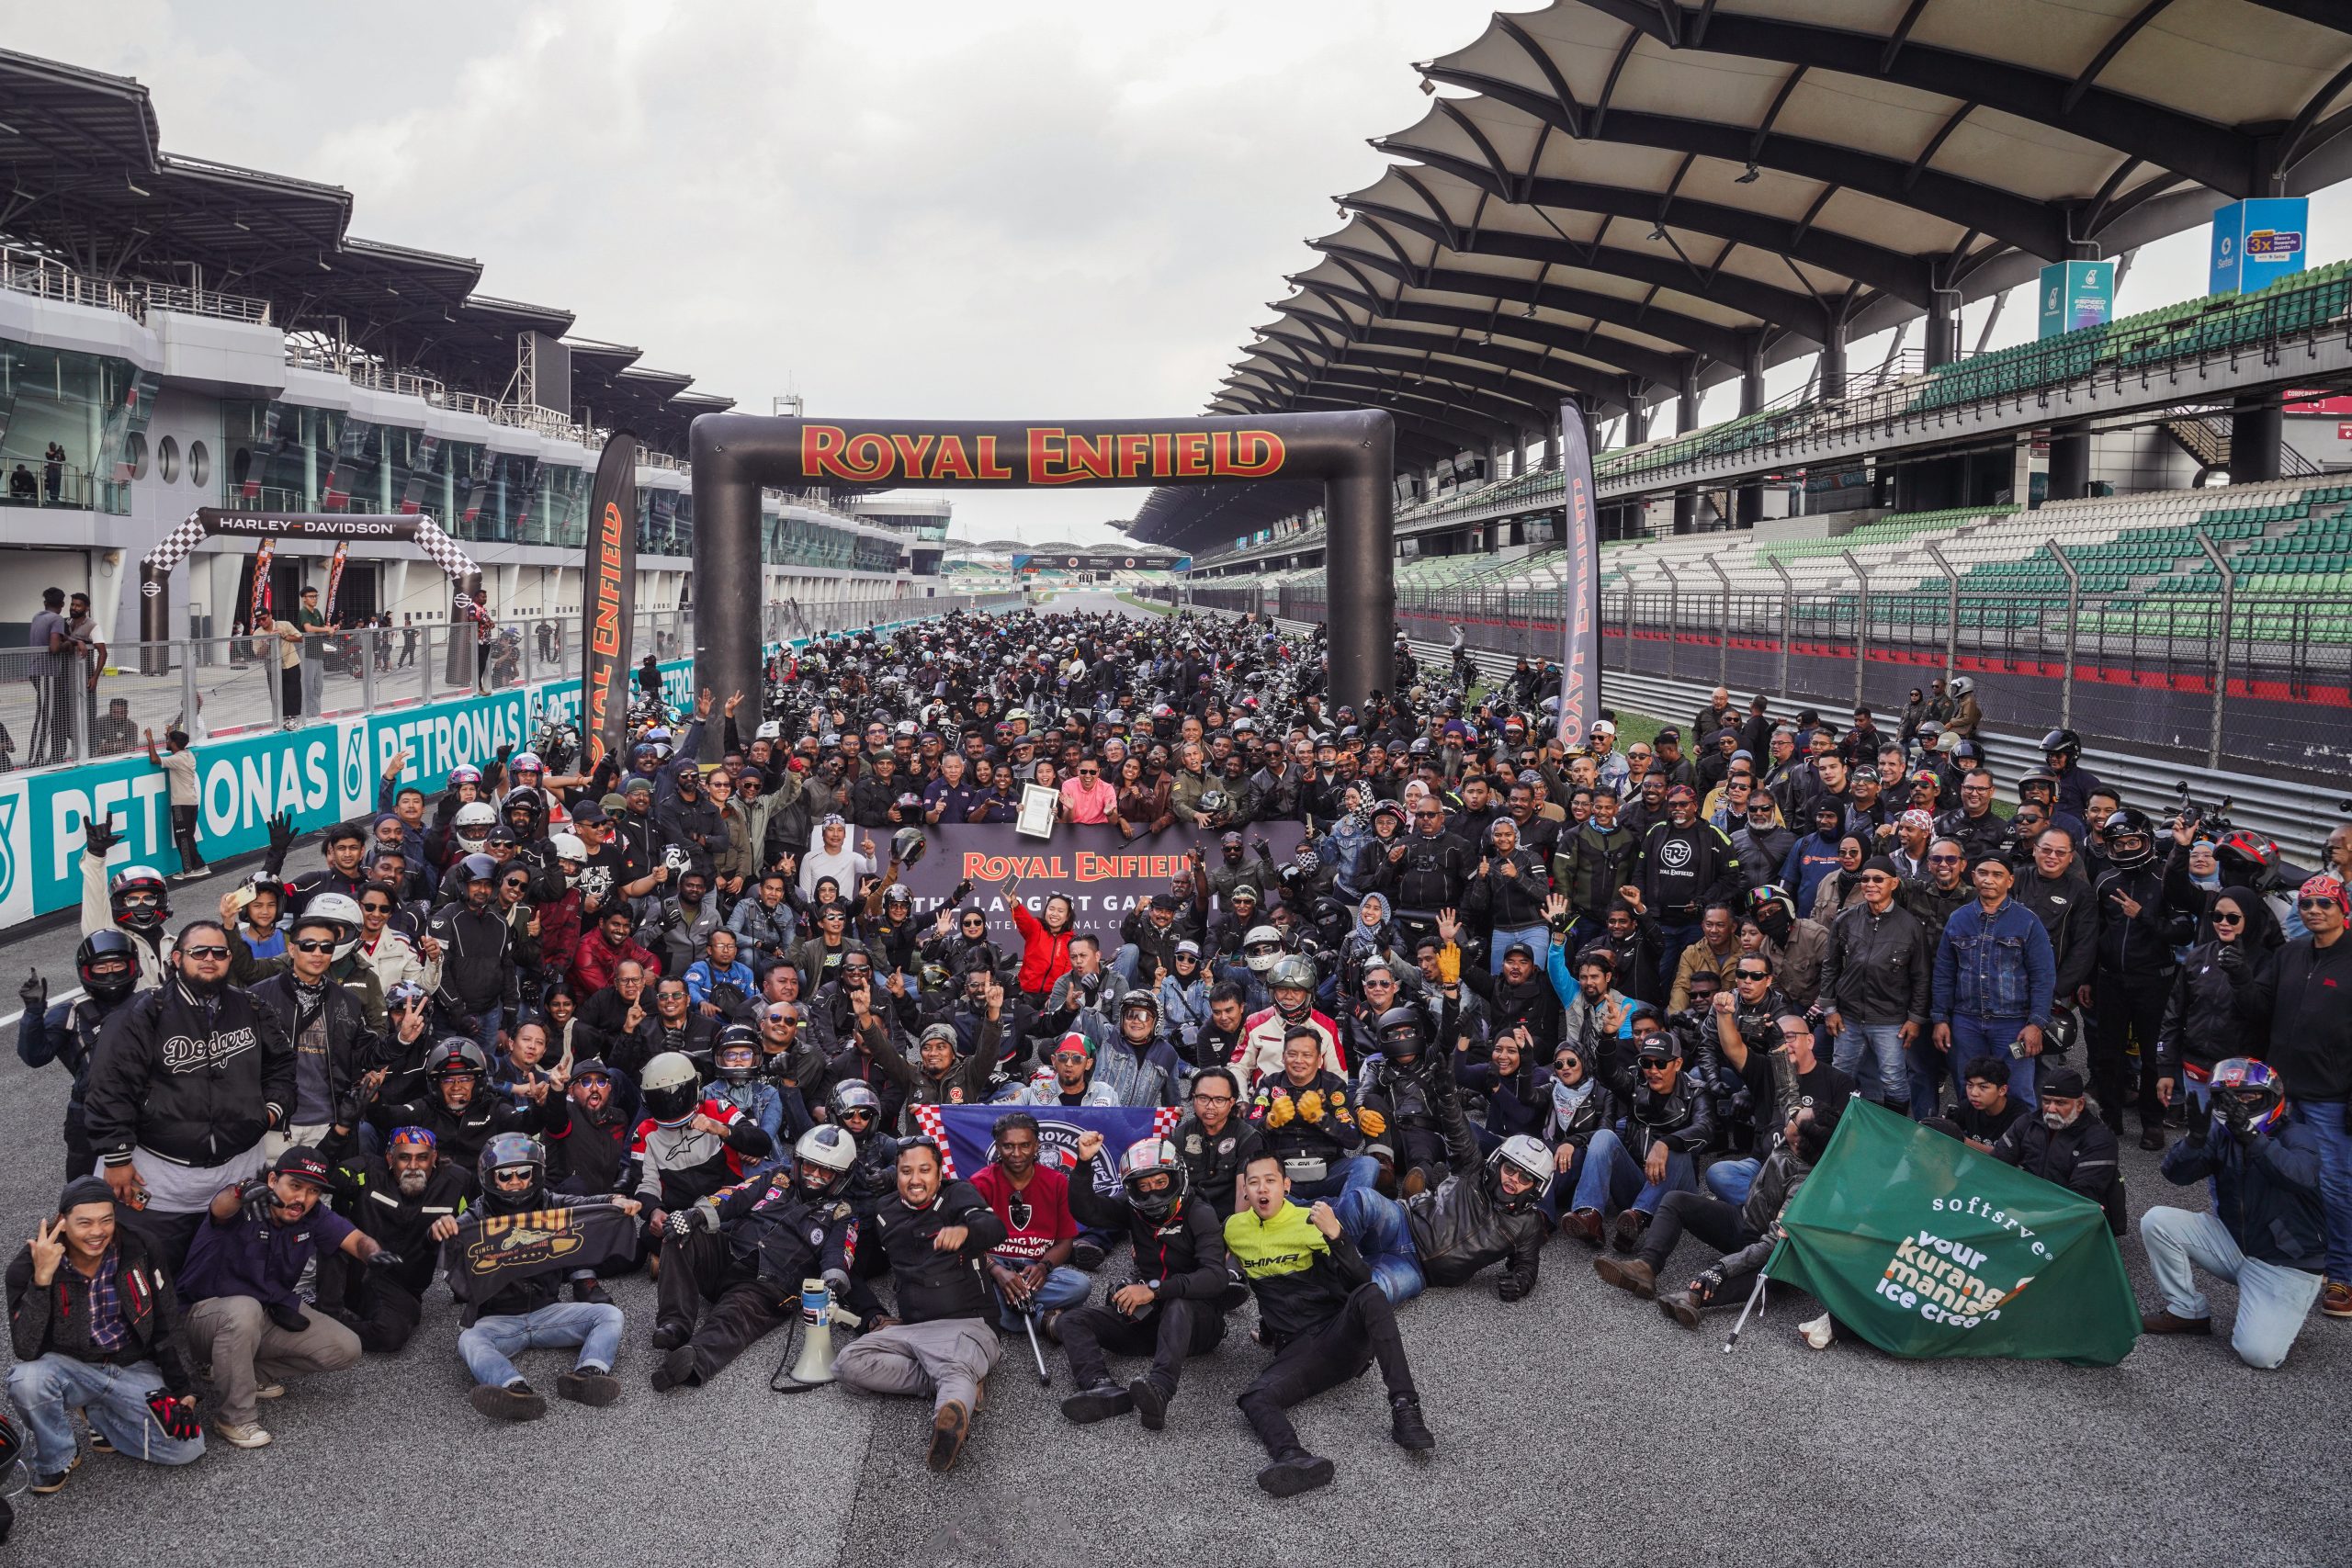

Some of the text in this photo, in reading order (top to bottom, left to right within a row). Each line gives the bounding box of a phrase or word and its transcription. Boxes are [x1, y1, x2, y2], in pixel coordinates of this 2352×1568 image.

[2251, 238, 2272, 252] 3x
[802, 424, 1286, 485] ROYAL ENFIELD
[594, 501, 623, 659] ENFIELD
[378, 703, 521, 787] PETRONAS
[51, 738, 330, 882] PETONAS
[963, 852, 1069, 882] ROYAL
[164, 1026, 255, 1068] Dodgers
[1037, 1131, 1079, 1149] ROYAL
[474, 1244, 495, 1256] SINCE
[1244, 1253, 1299, 1268] SHIMA
[1917, 1231, 1988, 1270] your
[1875, 1277, 1917, 1309] ice
[1887, 1258, 1980, 1315] manis
[1895, 1235, 2007, 1312] kurang
